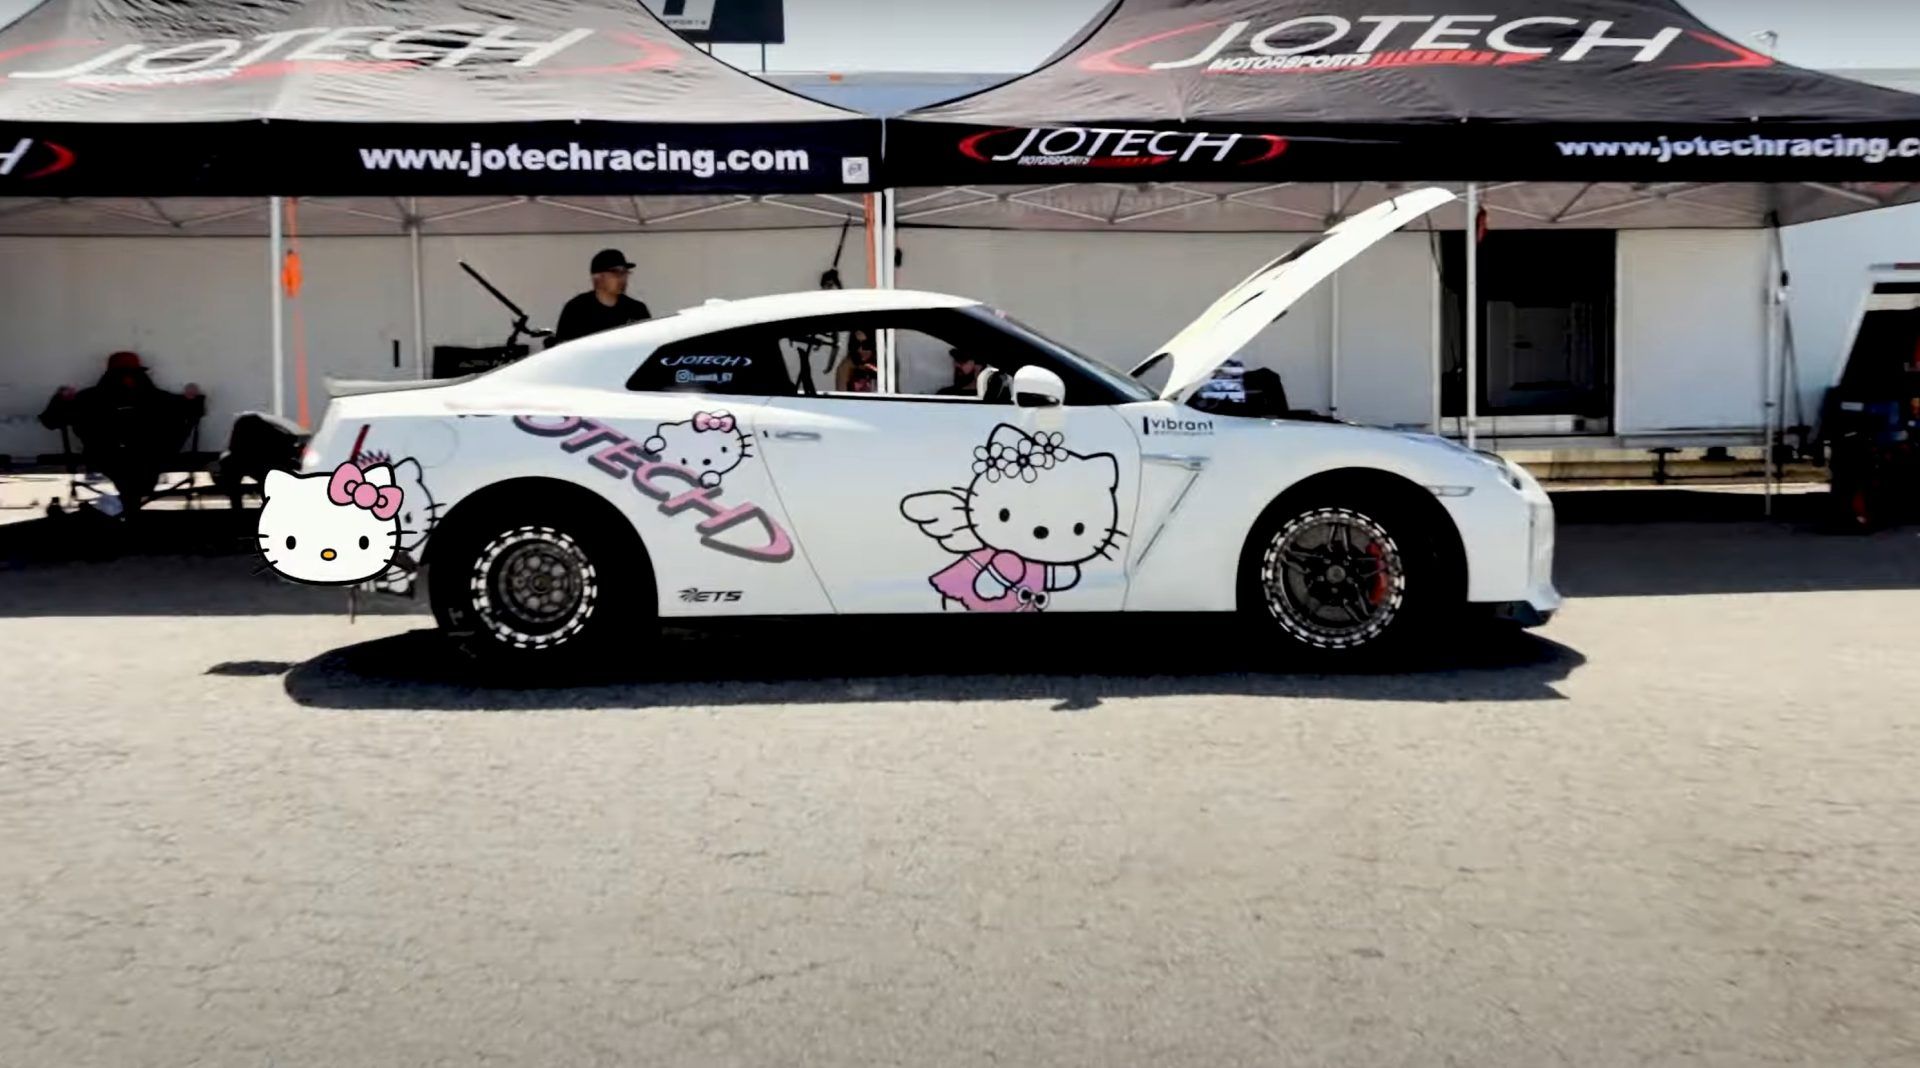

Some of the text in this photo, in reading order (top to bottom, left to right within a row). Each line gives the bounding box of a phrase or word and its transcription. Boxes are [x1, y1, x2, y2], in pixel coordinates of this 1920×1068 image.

[8, 26, 594, 80] JOTECH
[1150, 15, 1681, 70] JOTECH
[1207, 53, 1372, 71] MOTORSPORTS
[359, 142, 810, 177] www.jotechracing.com
[991, 127, 1243, 163] JOTECH
[1556, 134, 1920, 163] www.jotechracing.c
[664, 355, 741, 366] JOTECH
